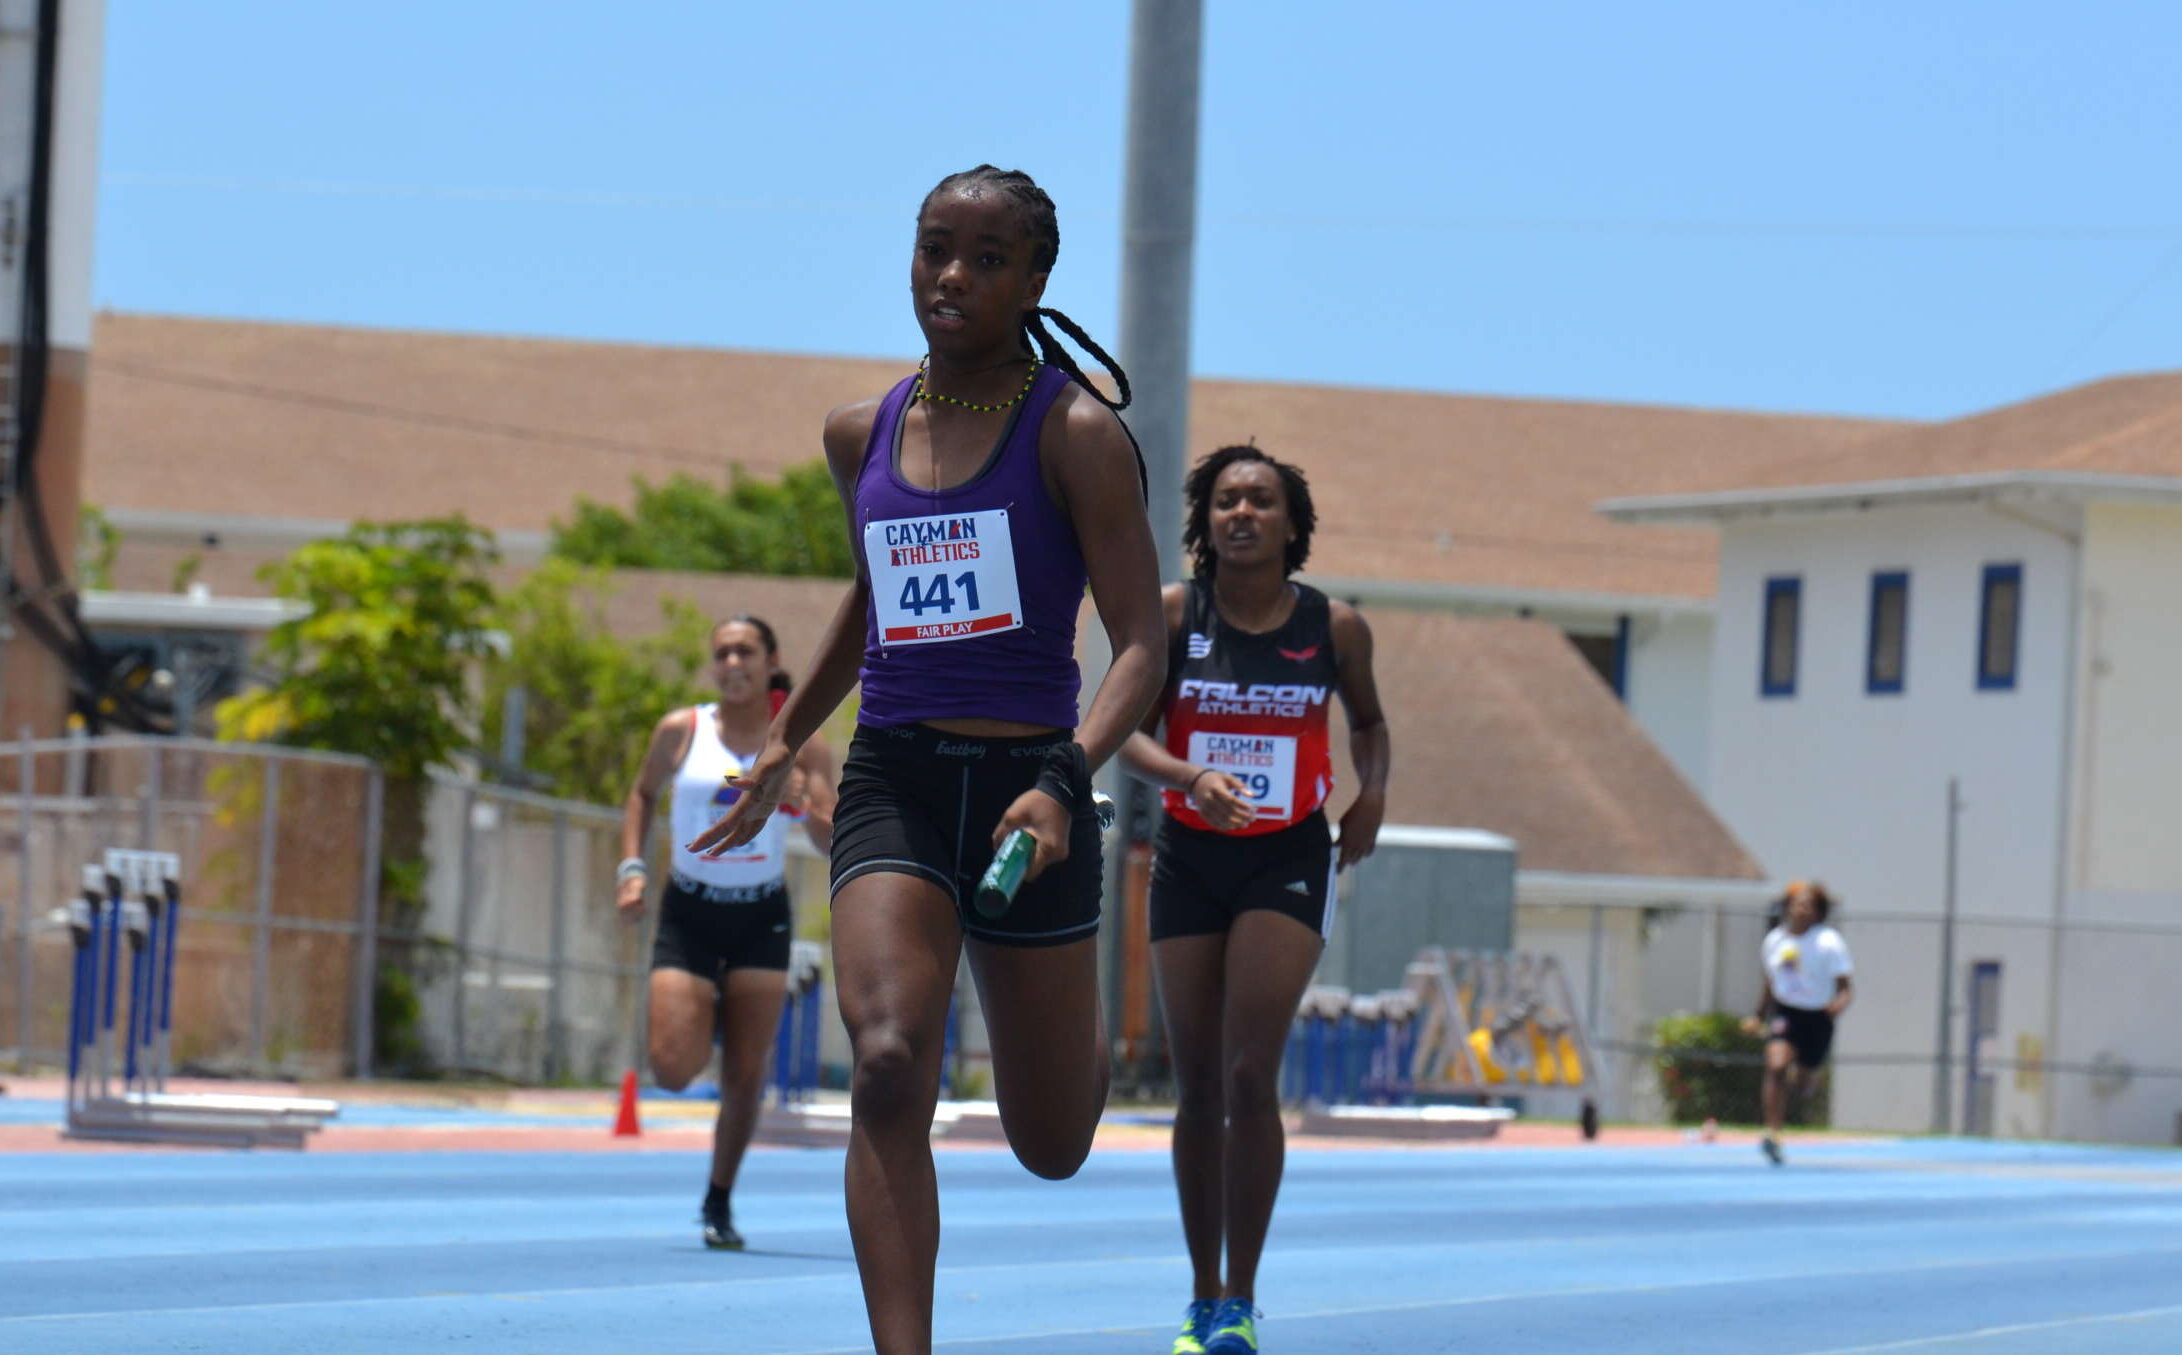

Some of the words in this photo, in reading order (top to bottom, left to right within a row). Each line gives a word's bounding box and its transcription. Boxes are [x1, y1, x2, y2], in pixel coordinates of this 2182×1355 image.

[886, 518, 977, 546] CAYMAN
[891, 542, 981, 566] ATHLETICS
[900, 571, 980, 616] 441
[917, 624, 941, 638] FAIR
[943, 622, 974, 636] PLAY
[1179, 679, 1326, 705] FALCON
[1197, 701, 1307, 717] ATHLETICS
[1207, 737, 1274, 754] CAYMAN
[1207, 752, 1274, 766] ATHLETICS
